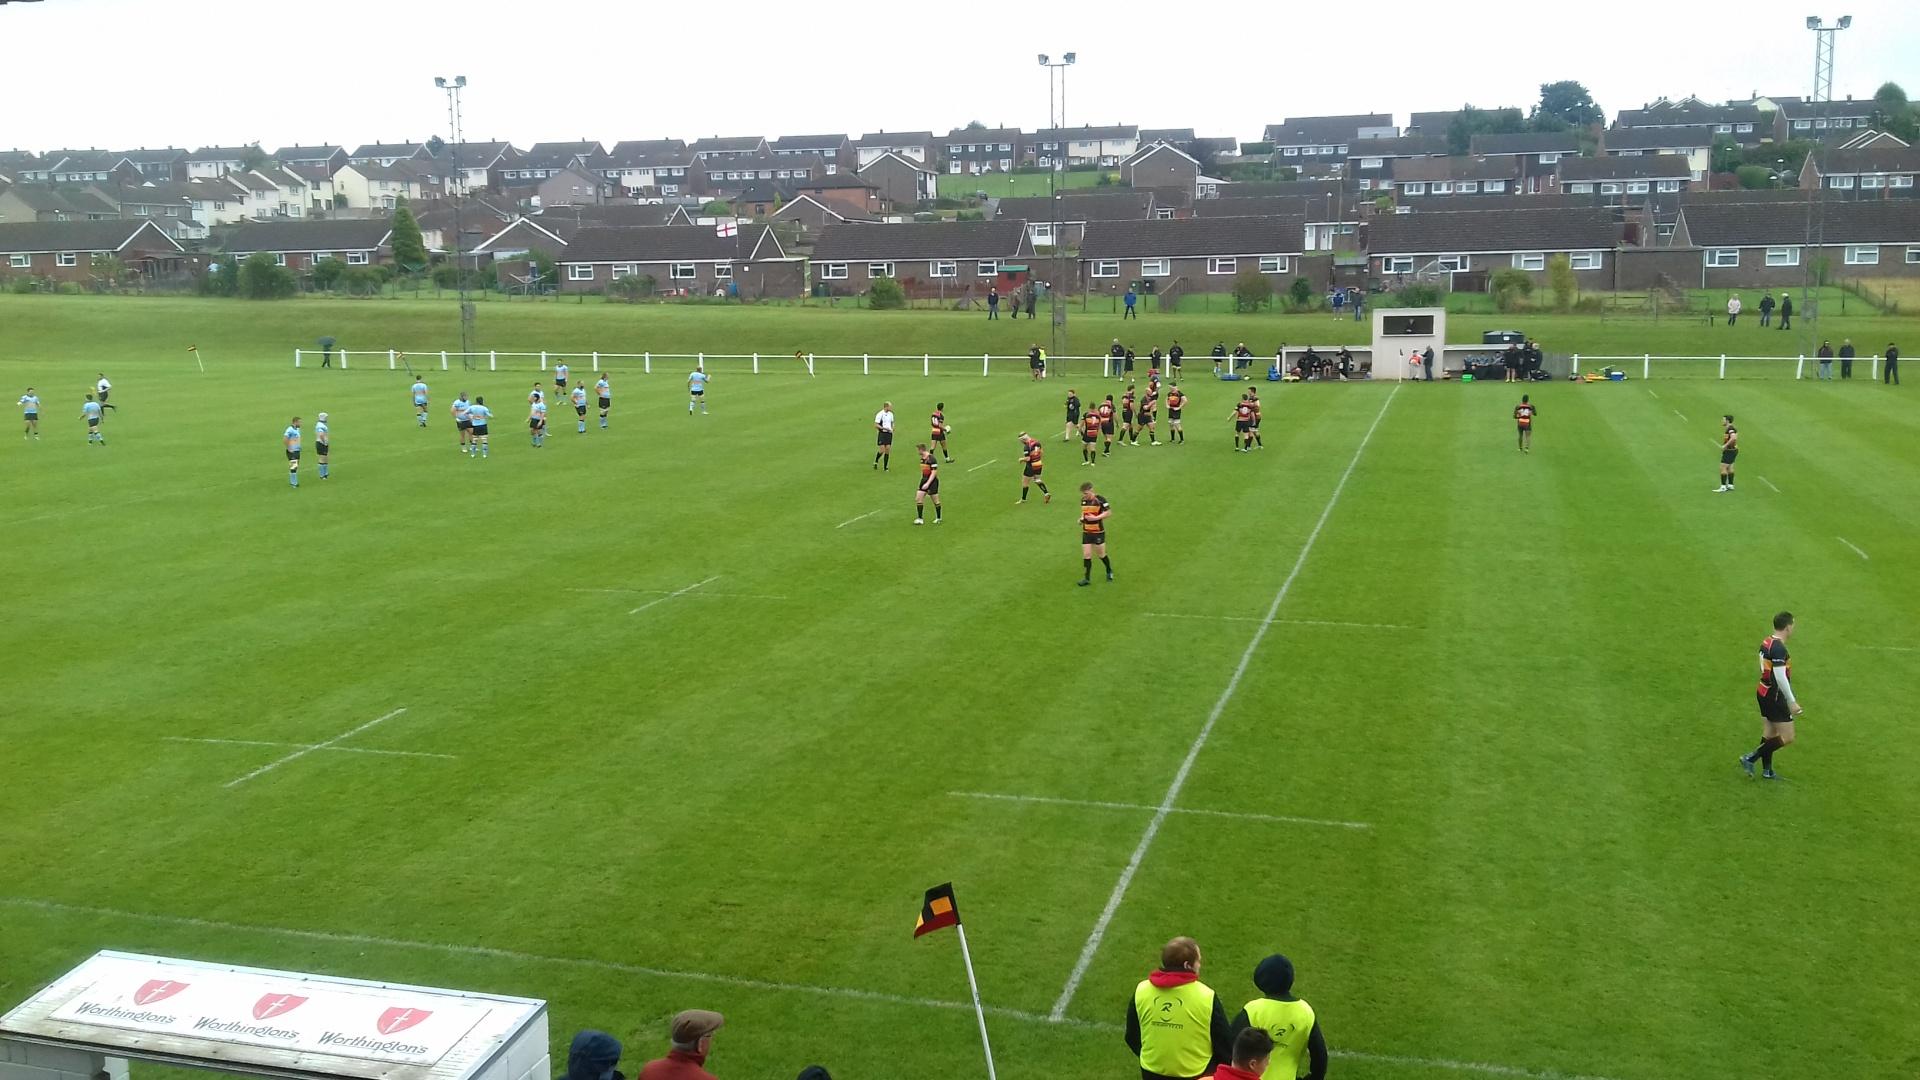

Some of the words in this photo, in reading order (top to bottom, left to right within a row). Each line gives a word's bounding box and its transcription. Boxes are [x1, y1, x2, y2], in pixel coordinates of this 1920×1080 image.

[75, 1001, 177, 1024] Worthington's
[192, 1016, 300, 1039] Worthington's
[318, 1031, 428, 1054] Worthington's
